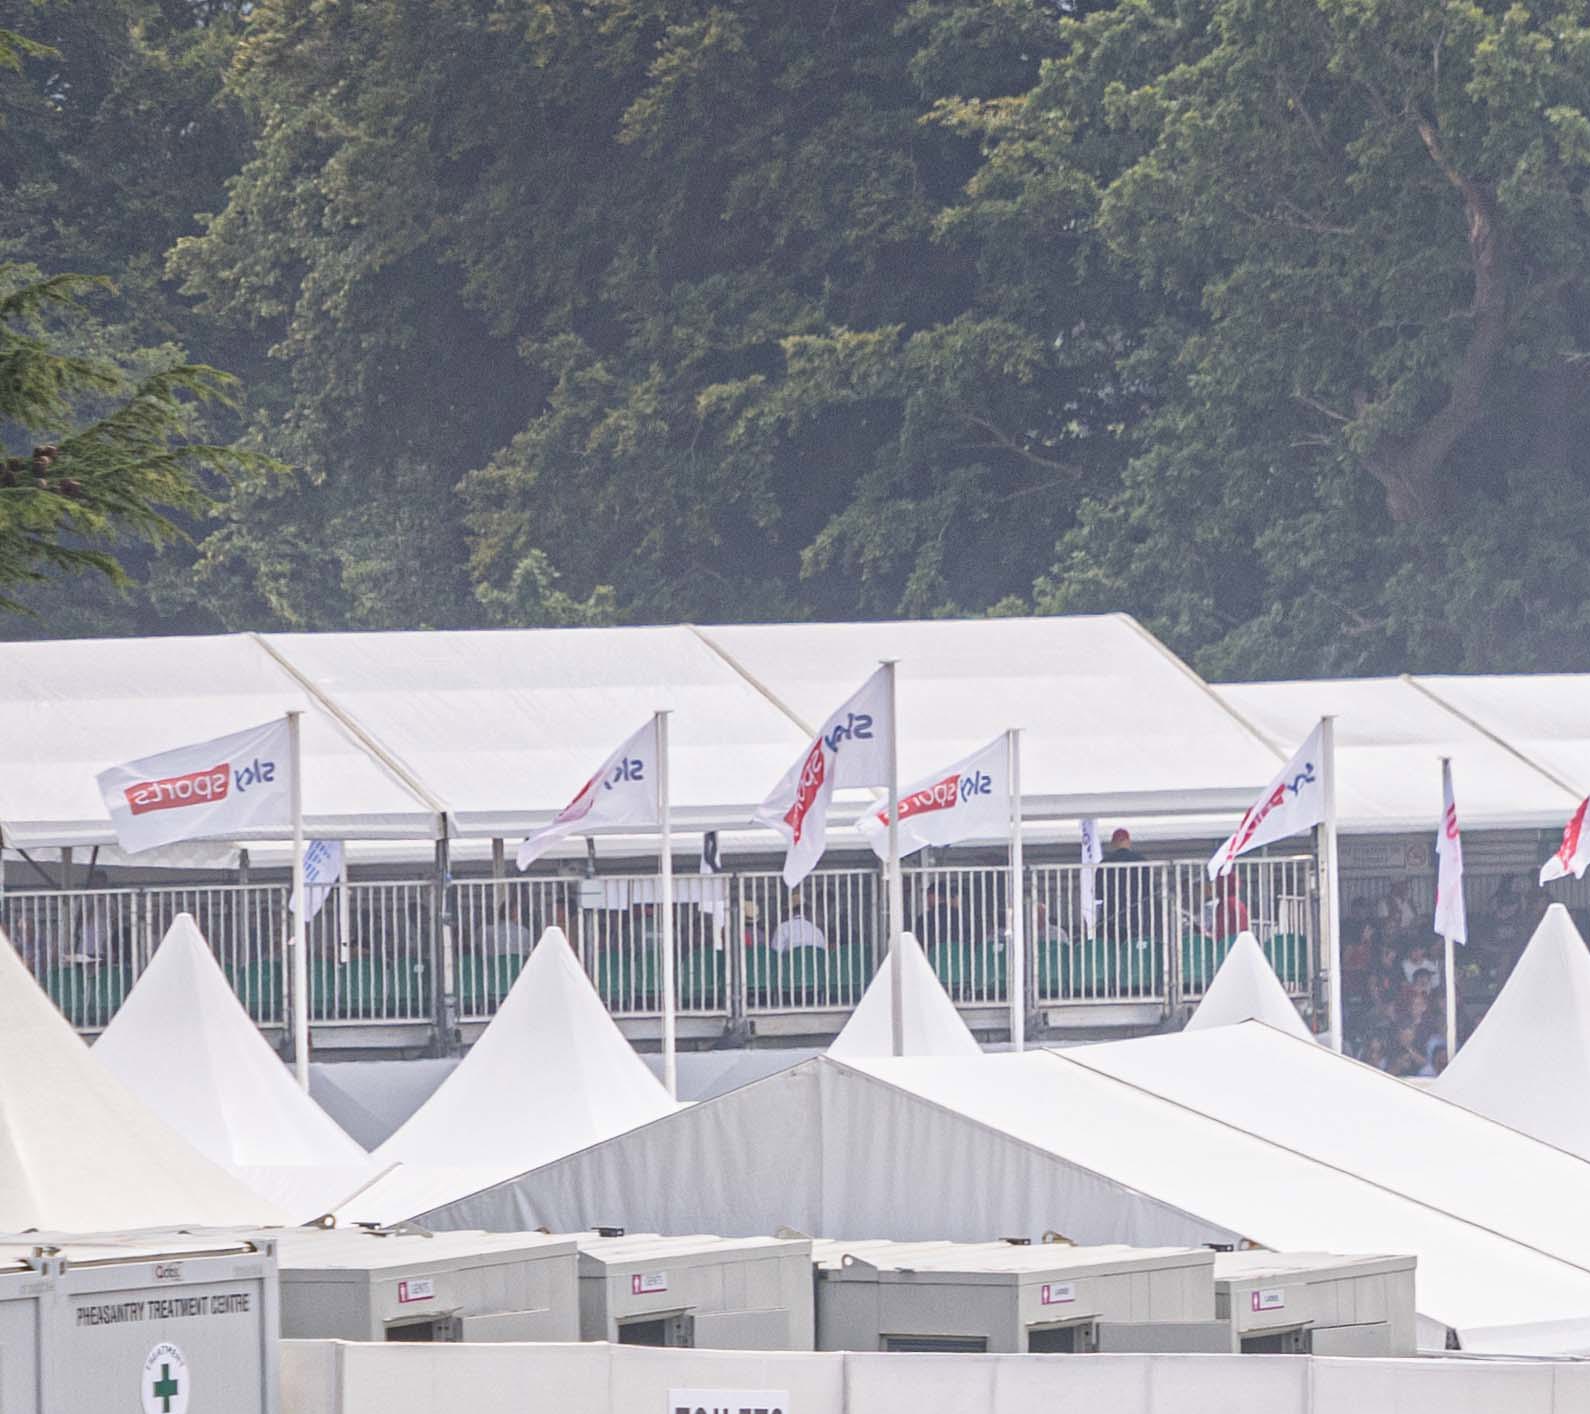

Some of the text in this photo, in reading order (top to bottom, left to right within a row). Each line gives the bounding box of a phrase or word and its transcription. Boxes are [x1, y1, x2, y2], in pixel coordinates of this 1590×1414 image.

[77, 1293, 249, 1326] PHEASANTRY TREATMENT CENTRE
